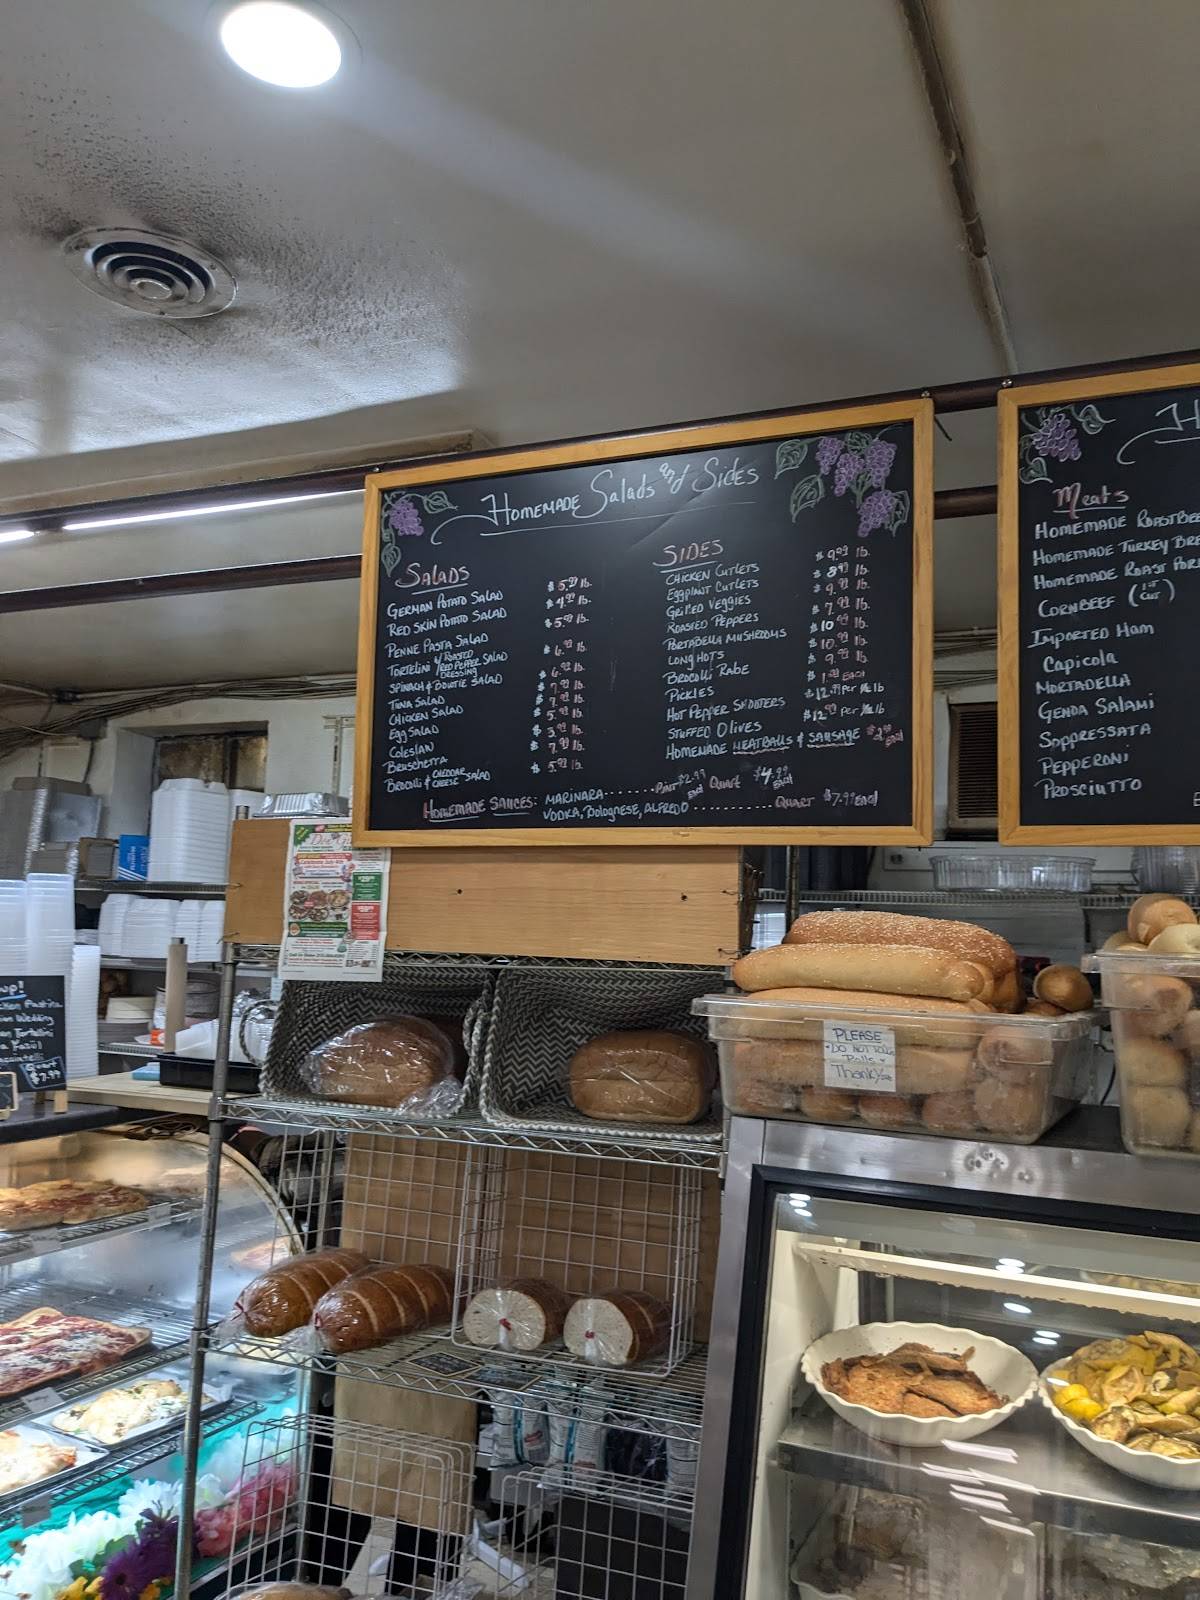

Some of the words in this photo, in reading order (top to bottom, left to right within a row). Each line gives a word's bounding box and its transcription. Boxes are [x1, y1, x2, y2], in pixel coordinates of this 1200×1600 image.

[572, 470, 655, 518] Salads
[659, 463, 689, 494] and
[1053, 482, 1130, 519] Meats
[1034, 516, 1127, 540] HOMEMADE
[652, 539, 724, 566] SIDES
[1033, 544, 1114, 567] HOMEMADE
[1118, 539, 1168, 555] TURKEY
[666, 569, 710, 585] CHICKEN
[715, 563, 760, 577] CUTLETS
[1033, 568, 1118, 590] HOMEMADE
[1124, 561, 1167, 577] ROAST
[715, 578, 759, 593] CUTLETS
[387, 601, 433, 620] GERMAN
[437, 593, 467, 609] POTATO
[471, 590, 503, 605] SALAD
[1038, 596, 1116, 617] CORNBEEF
[387, 623, 411, 637] RED
[413, 619, 437, 634] SKIN
[439, 614, 469, 628] POTATO
[472, 607, 508, 623] SALAD
[667, 620, 709, 634] ROASTED
[711, 613, 759, 629] PEPPERS
[384, 642, 420, 659] PENNE
[423, 638, 453, 653] PASTA
[456, 633, 489, 648] SALAD
[1028, 627, 1109, 648] IMPORTED
[482, 651, 509, 665] SALAD
[697, 651, 725, 663] HOTS
[1043, 649, 1118, 675] Capicola
[388, 681, 425, 694] SPINACH
[471, 673, 503, 687] SALAD
[664, 686, 715, 702] PICKLES
[1035, 673, 1131, 694] MORTADELLA
[388, 698, 413, 711] TUNA
[415, 695, 445, 707] SALAD
[1038, 701, 1088, 724] GENOA
[388, 712, 429, 726] CHICKEN
[431, 705, 464, 718] SALAD
[666, 707, 687, 722] HOT
[408, 724, 439, 738] SALAD
[667, 726, 711, 740] STUFFED
[665, 743, 728, 760] HOMEMADE
[808, 728, 861, 743] SAUSAGE
[1038, 744, 1129, 776] PEPPERONI
[545, 788, 604, 805] MARINARA
[1034, 778, 1142, 799] PROSCIUTTO
[423, 799, 486, 819] HOMEMADE
[644, 802, 690, 815] ALFREDO
[832, 1028, 882, 1042] PLEASE
